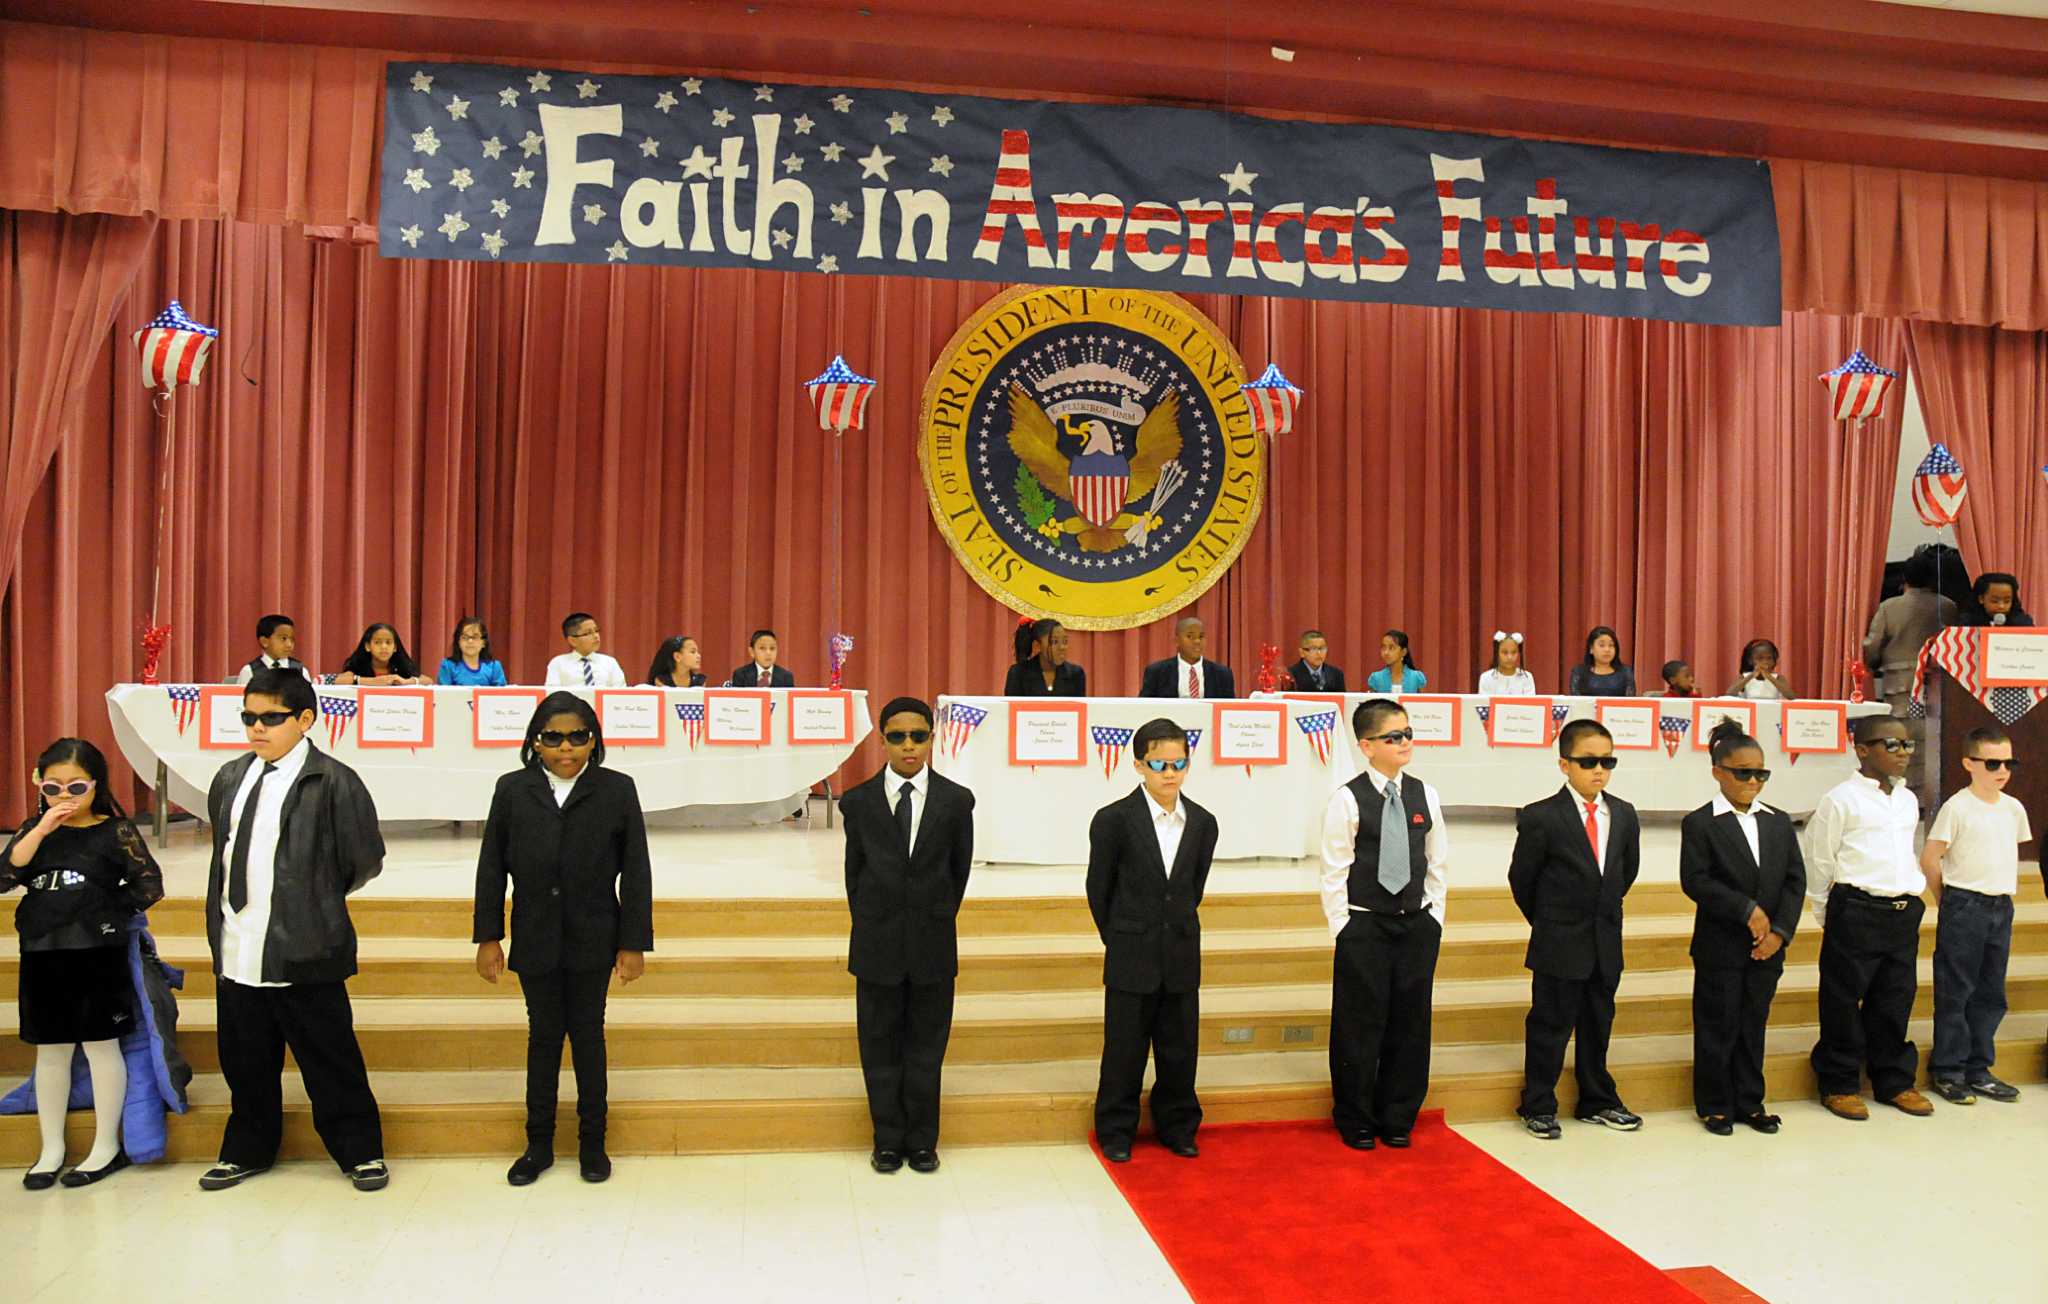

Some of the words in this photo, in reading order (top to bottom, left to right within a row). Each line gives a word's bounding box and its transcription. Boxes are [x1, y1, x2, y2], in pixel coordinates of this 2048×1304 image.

[534, 103, 814, 261] Faith
[857, 145, 951, 262] in
[972, 129, 1409, 286] America's
[1430, 153, 1711, 297] Future
[1109, 296, 1137, 314] OF
[1142, 303, 1180, 336] THE
[933, 288, 1098, 431] PRESIDENT
[1180, 329, 1256, 459] UNITED
[934, 427, 956, 466] THE
[937, 466, 960, 494] OF
[950, 490, 1023, 583] SEAL
[1175, 467, 1256, 583] STATES
